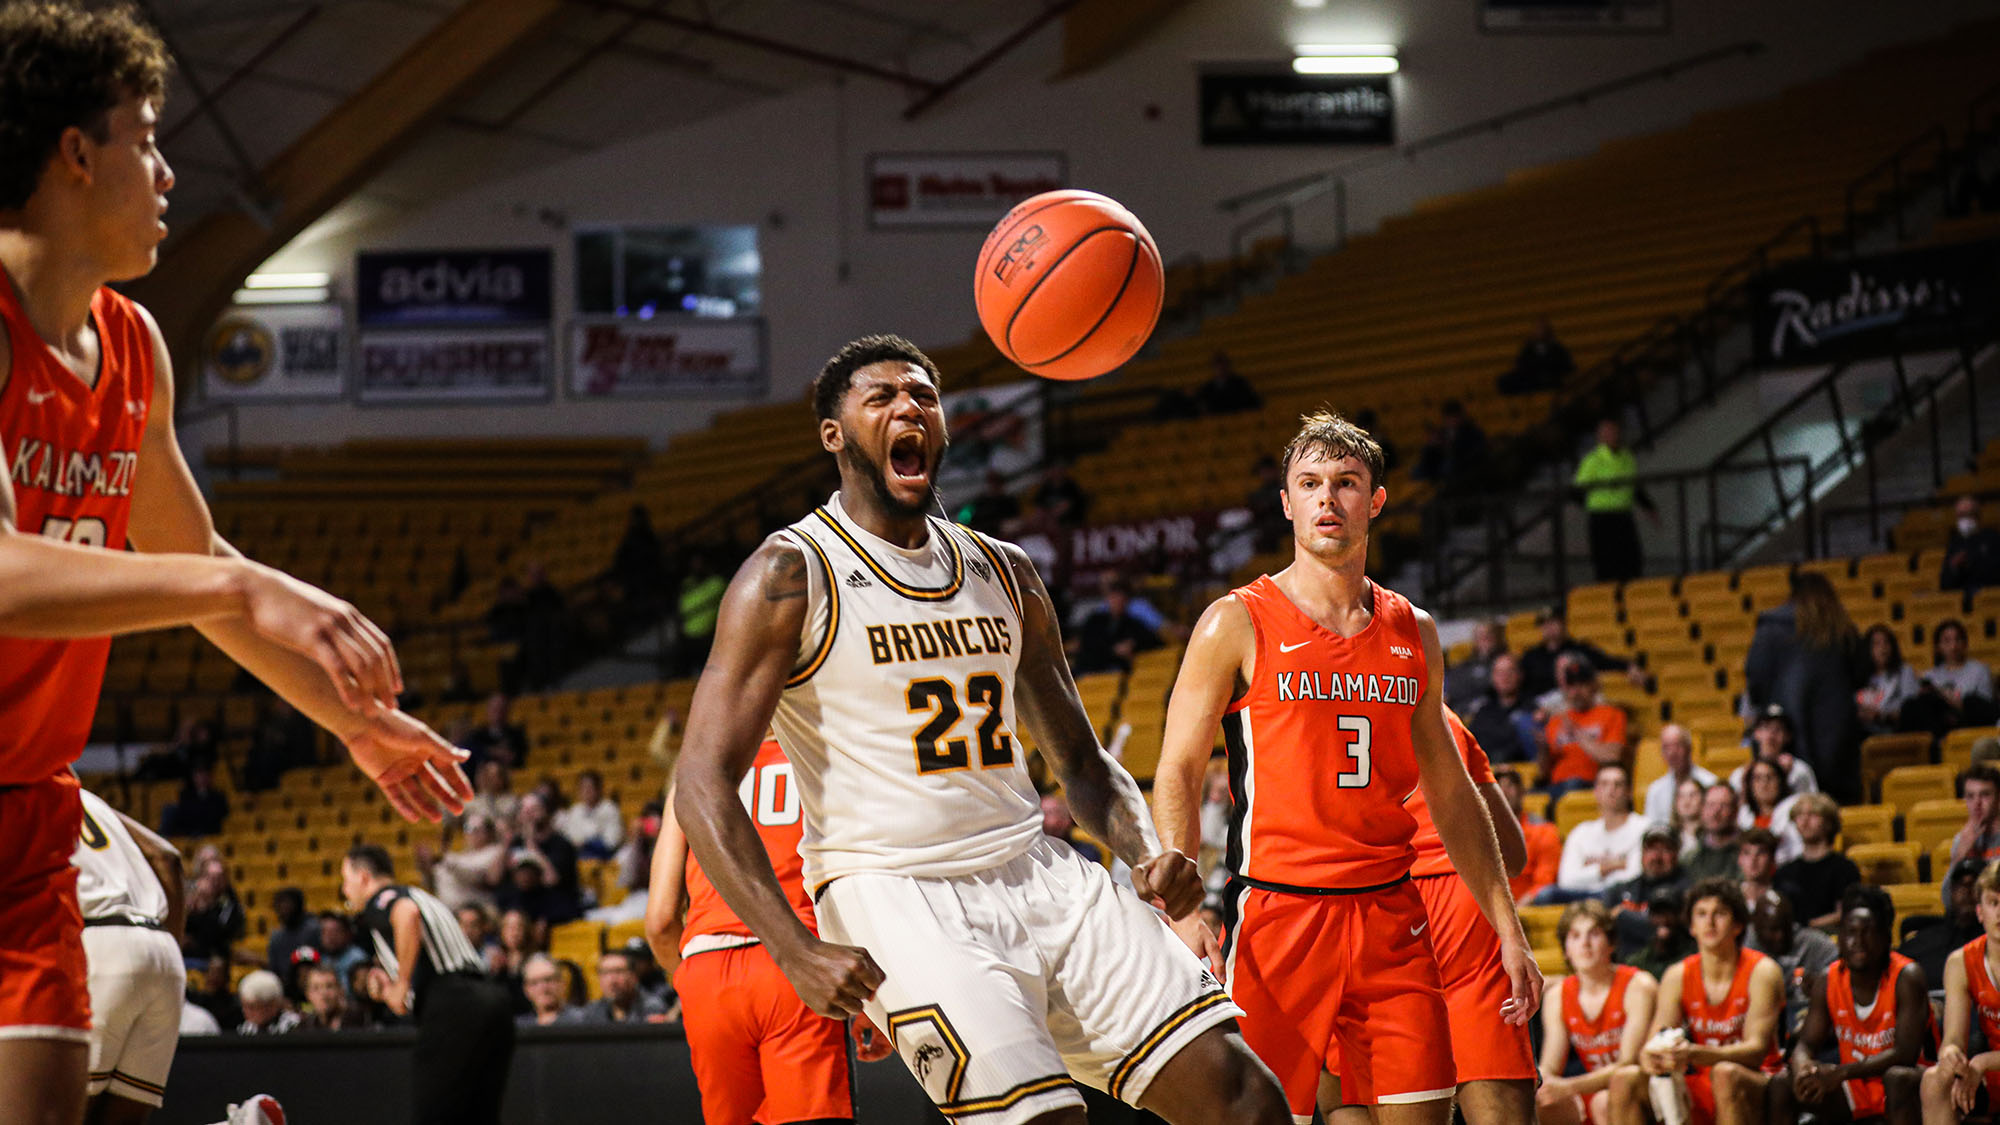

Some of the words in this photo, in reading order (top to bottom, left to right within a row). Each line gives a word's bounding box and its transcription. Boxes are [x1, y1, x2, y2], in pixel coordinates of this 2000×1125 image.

[994, 224, 1044, 281] PRO
[380, 257, 524, 302] advia
[1071, 516, 1198, 564] HONOR
[865, 615, 1012, 665] BRONCOS
[1277, 671, 1419, 706] KALAMAZOO
[904, 671, 1015, 776] 22
[1337, 714, 1372, 789] 3
